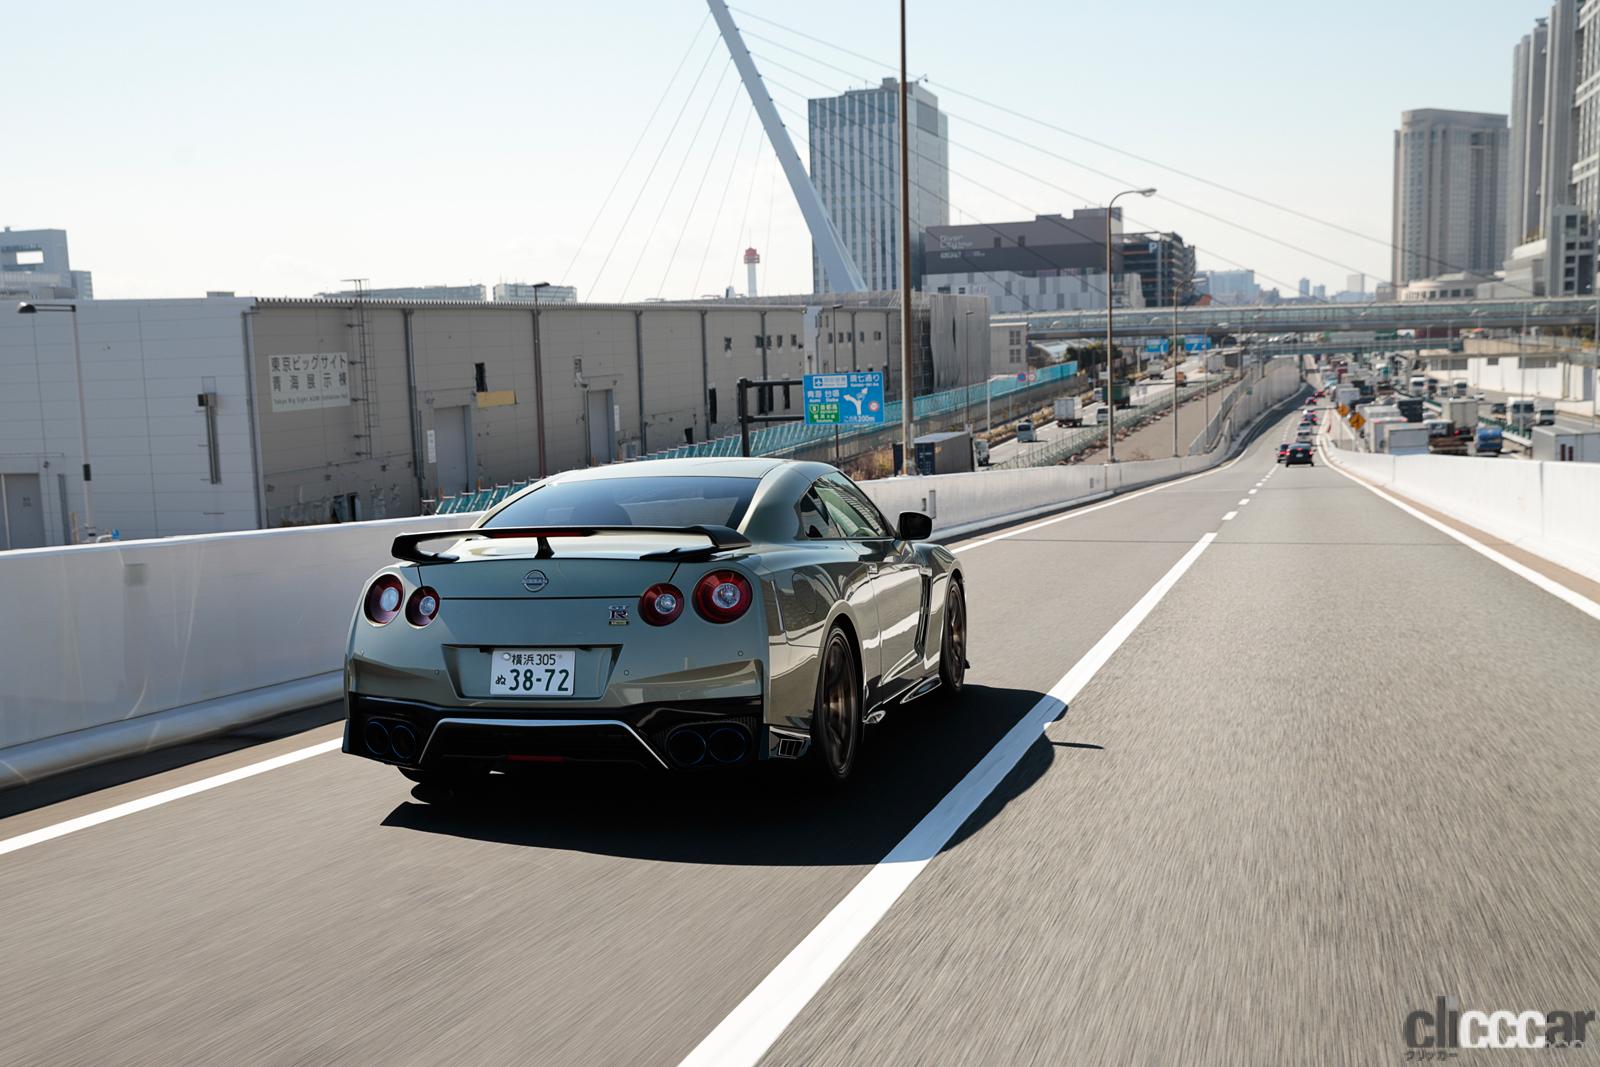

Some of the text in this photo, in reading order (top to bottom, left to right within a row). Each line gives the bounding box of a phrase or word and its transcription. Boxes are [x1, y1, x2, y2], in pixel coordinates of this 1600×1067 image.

[271, 354, 347, 372] 東京ビッグサイト
[511, 653, 556, 666] 横浜 305
[495, 668, 570, 692] ぬ 38-72
